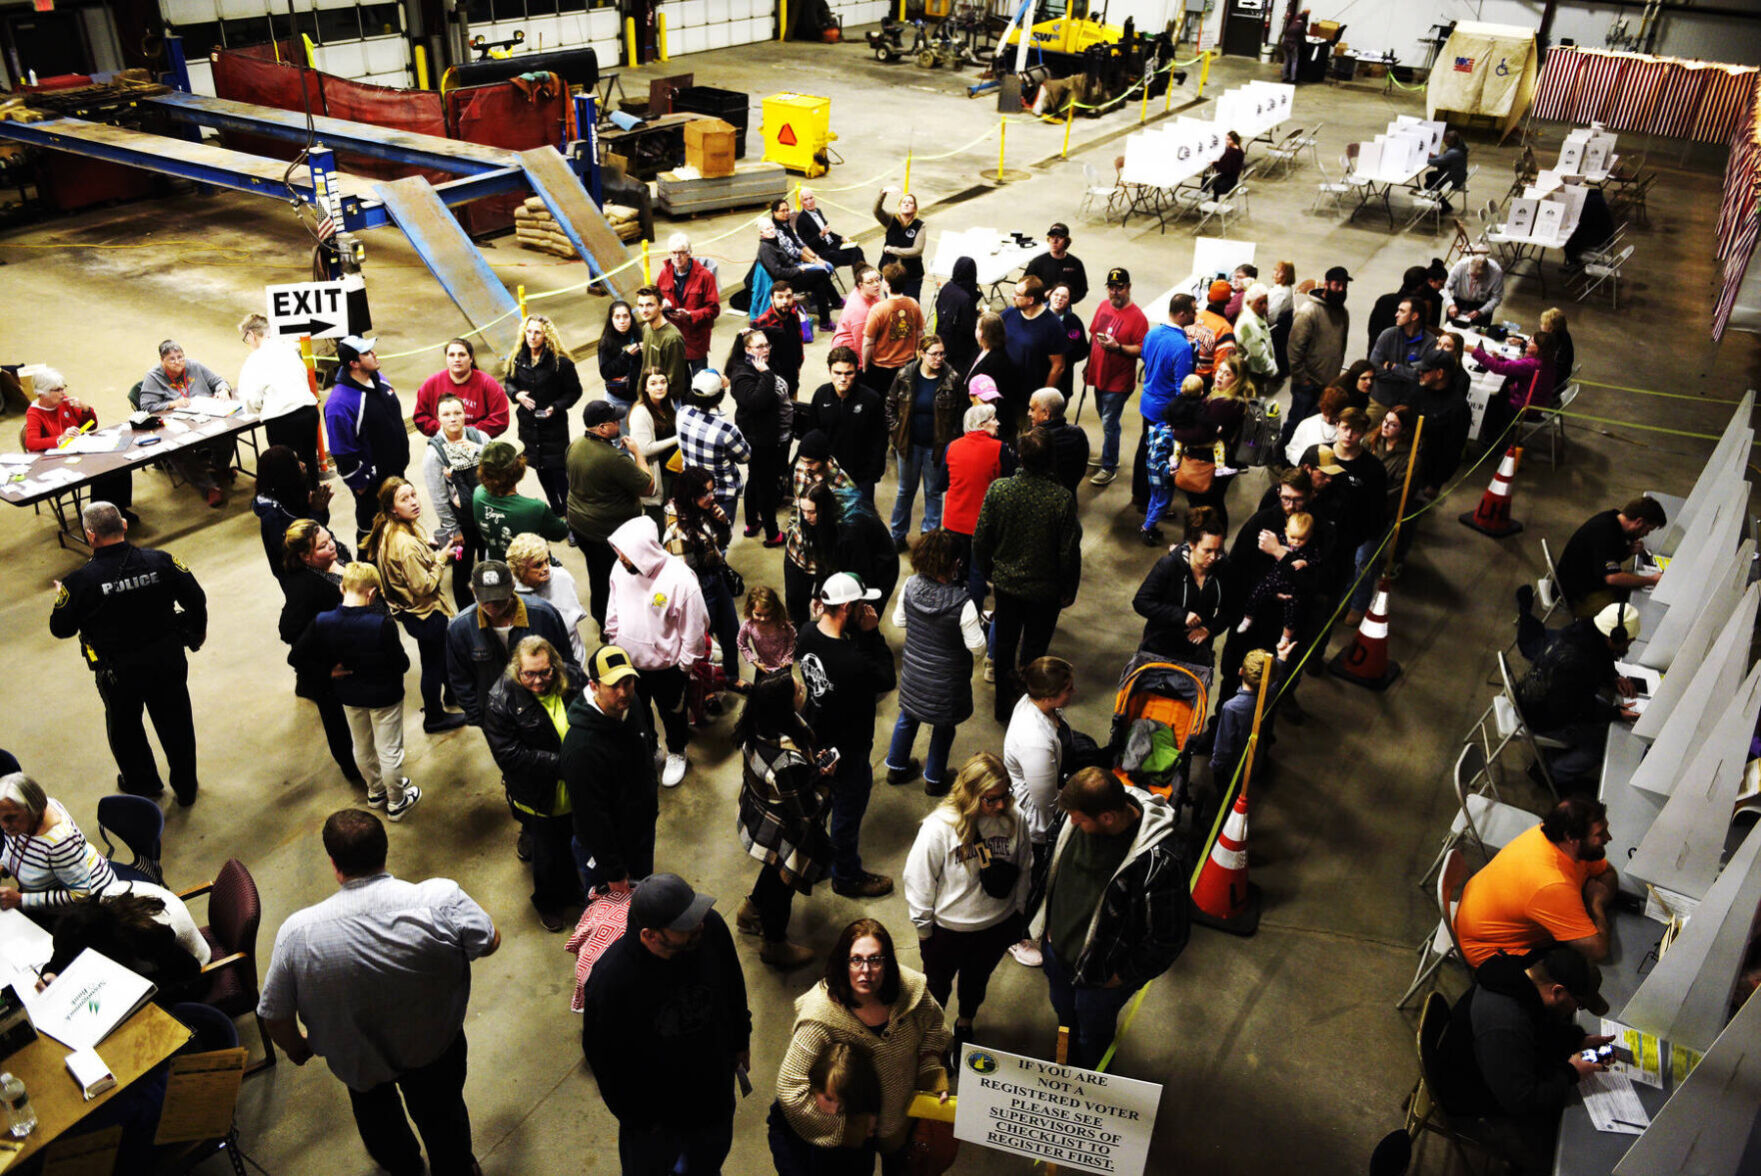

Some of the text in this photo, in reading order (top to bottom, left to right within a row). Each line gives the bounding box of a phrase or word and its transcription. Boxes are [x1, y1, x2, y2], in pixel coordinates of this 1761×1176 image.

[273, 288, 342, 317] EXIT
[101, 572, 160, 595] POLICE
[1019, 1059, 1108, 1087] IF YOU ARE
[1037, 1077, 1085, 1096] NOT A
[980, 1078, 1140, 1121] REGISTERED VOTER
[1011, 1098, 1103, 1127] PLEASE SEE
[989, 1106, 1122, 1144] SUPERVISORS OF
[996, 1121, 1111, 1155] CHECKLIST TO
[987, 1132, 1115, 1170] REGISTER FIRST.
